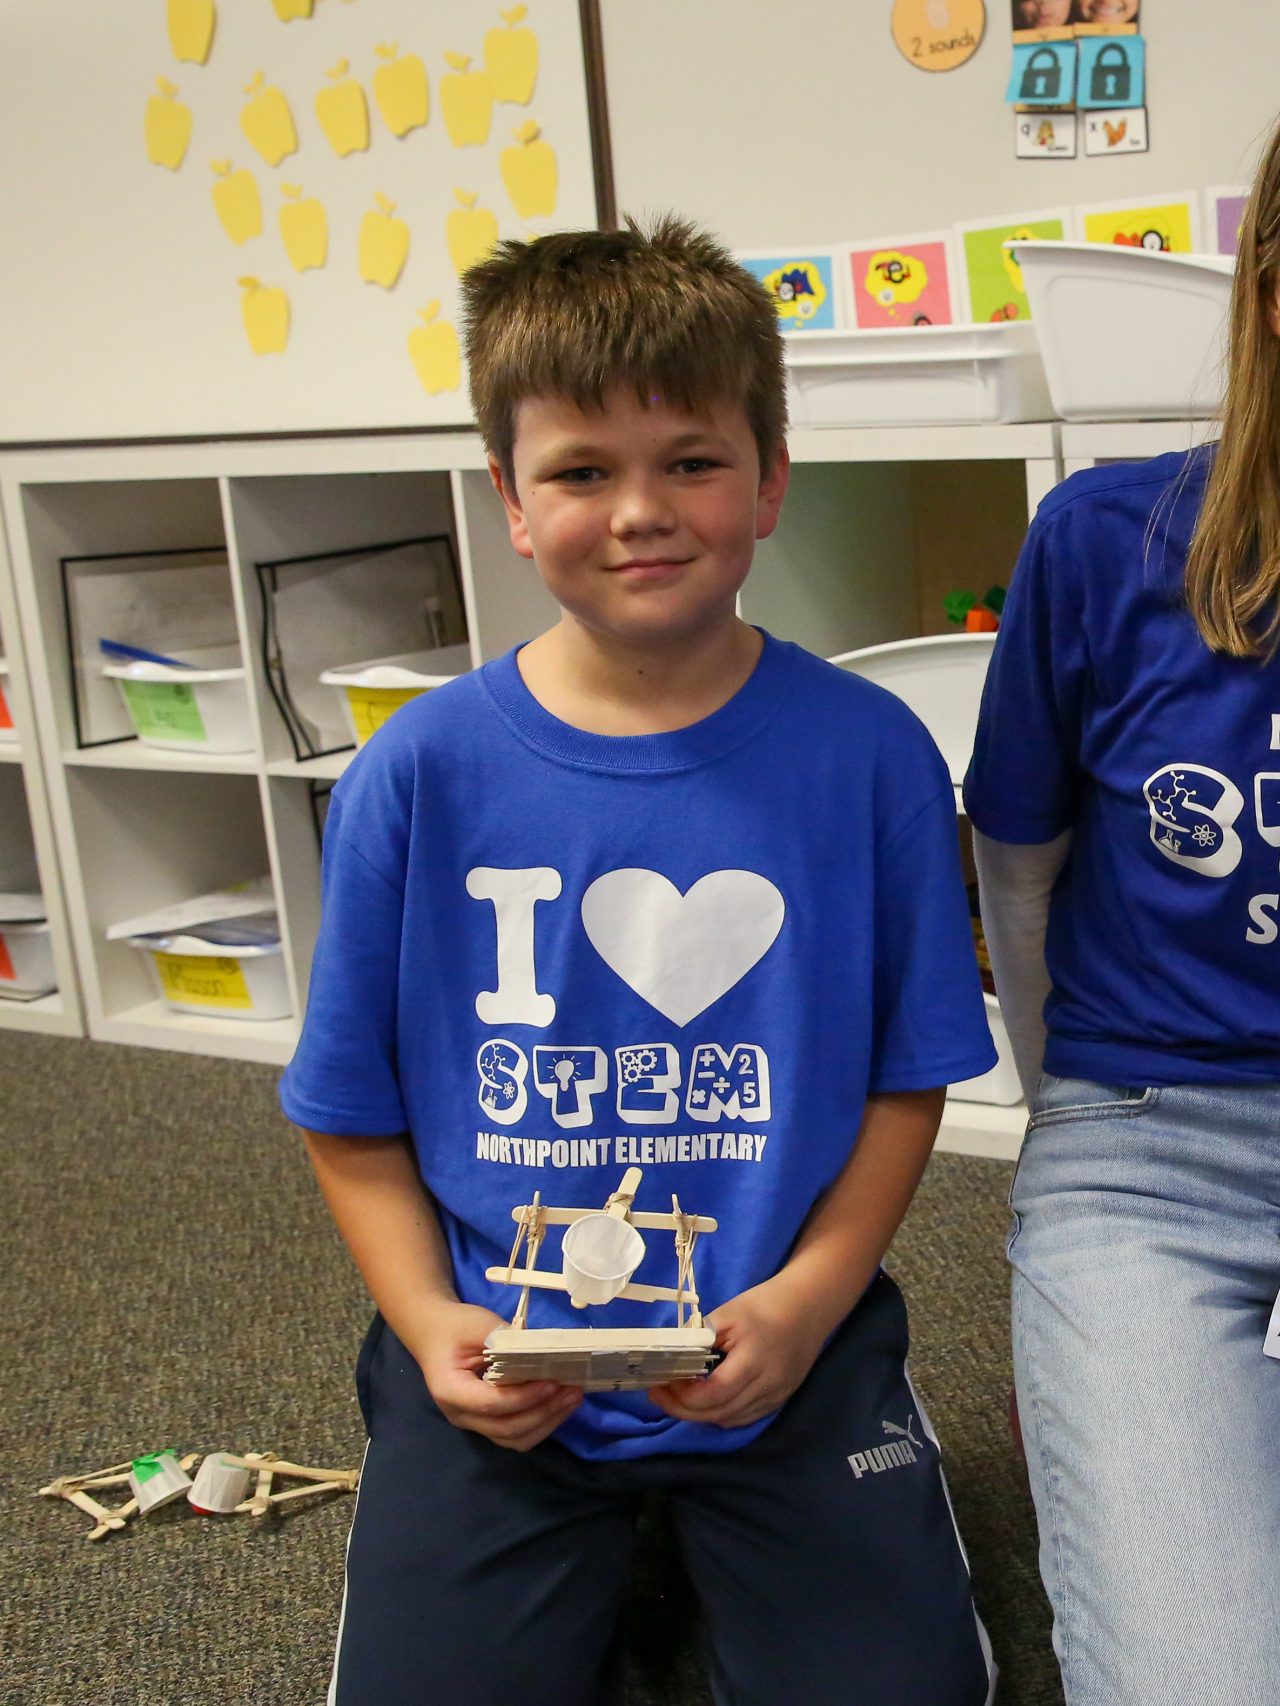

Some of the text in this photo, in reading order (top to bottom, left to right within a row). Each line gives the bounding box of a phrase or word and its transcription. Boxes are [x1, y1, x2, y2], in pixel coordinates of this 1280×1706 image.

[911, 27, 977, 57] 2 sounds
[465, 866, 562, 1028] I
[476, 1038, 772, 1129] STEM
[476, 1131, 768, 1168] NORTHPOINT ELEMENTARY
[847, 1440, 917, 1479] PUMA
